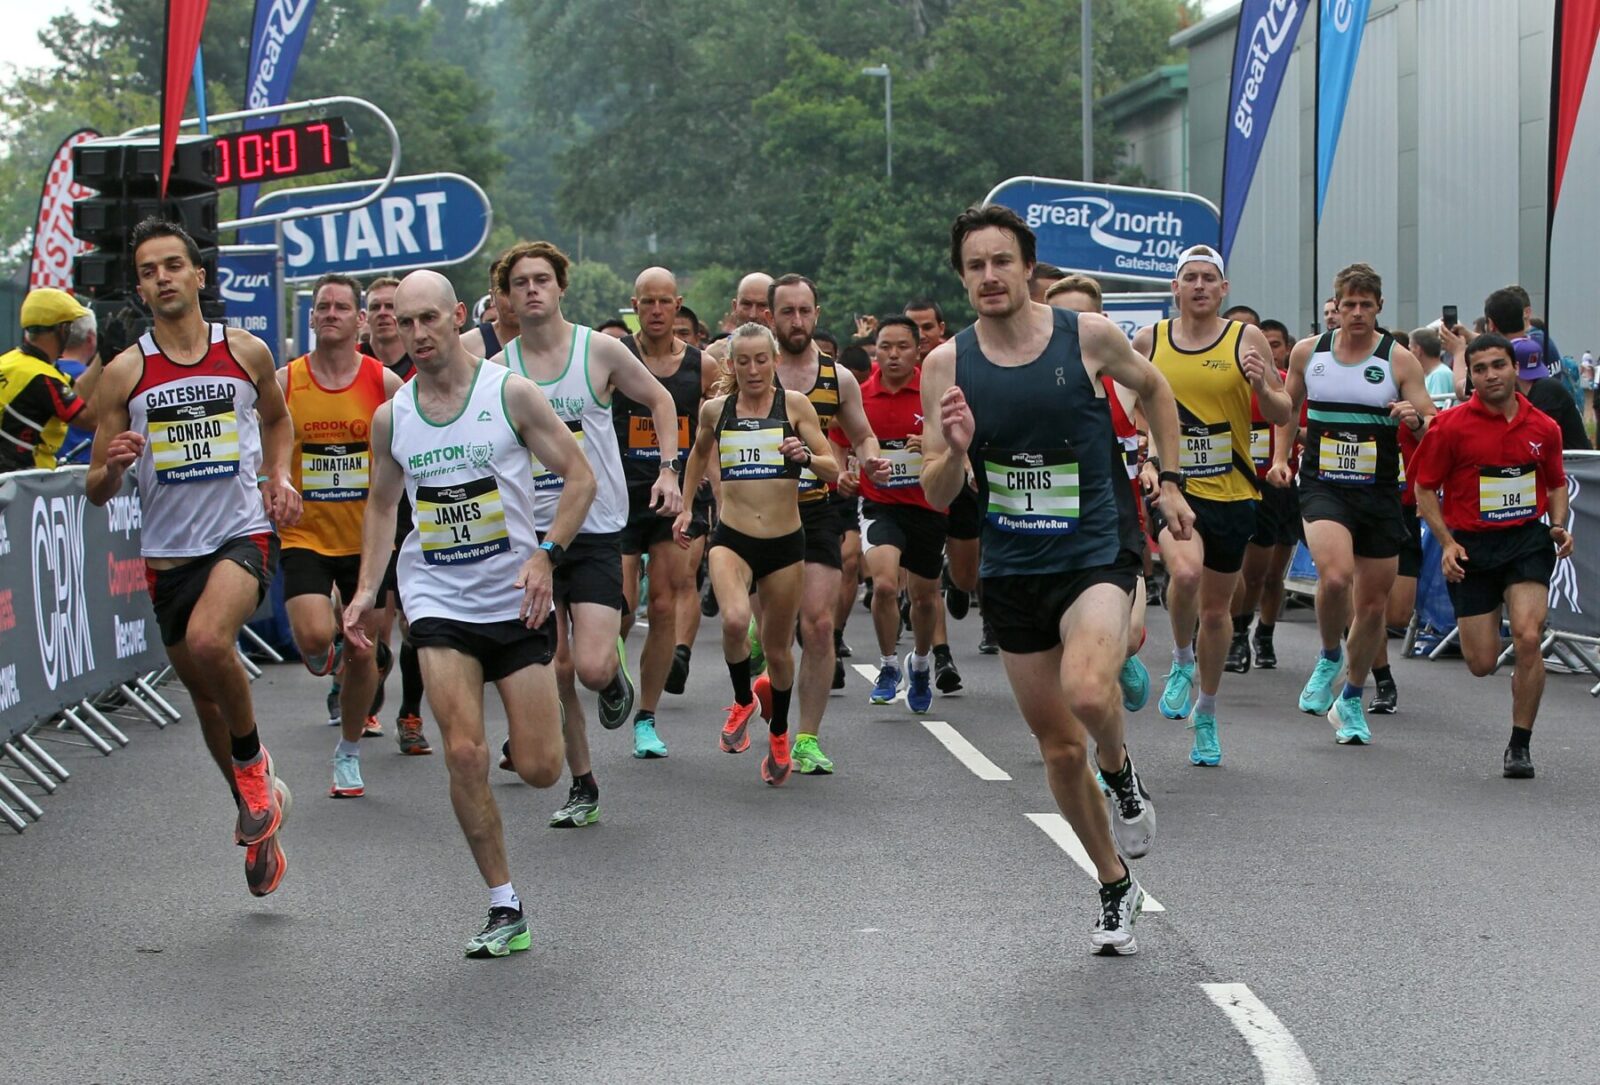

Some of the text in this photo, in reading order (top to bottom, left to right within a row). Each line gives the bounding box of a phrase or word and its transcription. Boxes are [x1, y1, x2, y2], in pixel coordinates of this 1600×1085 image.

[250, 24, 287, 118] great
[1235, 44, 1270, 139] great
[1026, 203, 1182, 237] great north
[281, 191, 447, 267] START
[1142, 238, 1184, 259] 10k
[233, 274, 269, 288] run
[146, 383, 237, 409] GATESHEAD
[167, 420, 221, 443] CONRAD
[303, 420, 349, 432] CROOK
[183, 442, 211, 462] 104
[1187, 438, 1213, 451] CARL
[1336, 444, 1360, 457] LIAM
[309, 456, 362, 472] JONATHAN
[408, 445, 465, 470] HEATON
[740, 448, 761, 463] 176
[1194, 452, 1208, 464] 18
[1337, 457, 1357, 470] 106
[167, 464, 234, 480] #TogetherWeRun
[333, 473, 340, 487] 6
[420, 465, 456, 480] Harriers
[1006, 471, 1052, 491] CHRIS
[311, 490, 363, 499] #TogetherWeRun
[1025, 492, 1034, 511] 1
[1502, 493, 1521, 507] 184
[435, 502, 482, 526] JAMES
[998, 516, 1068, 529] #TogetherWeRun
[451, 524, 471, 544] 14
[434, 543, 500, 563] #TogetherWeRun
